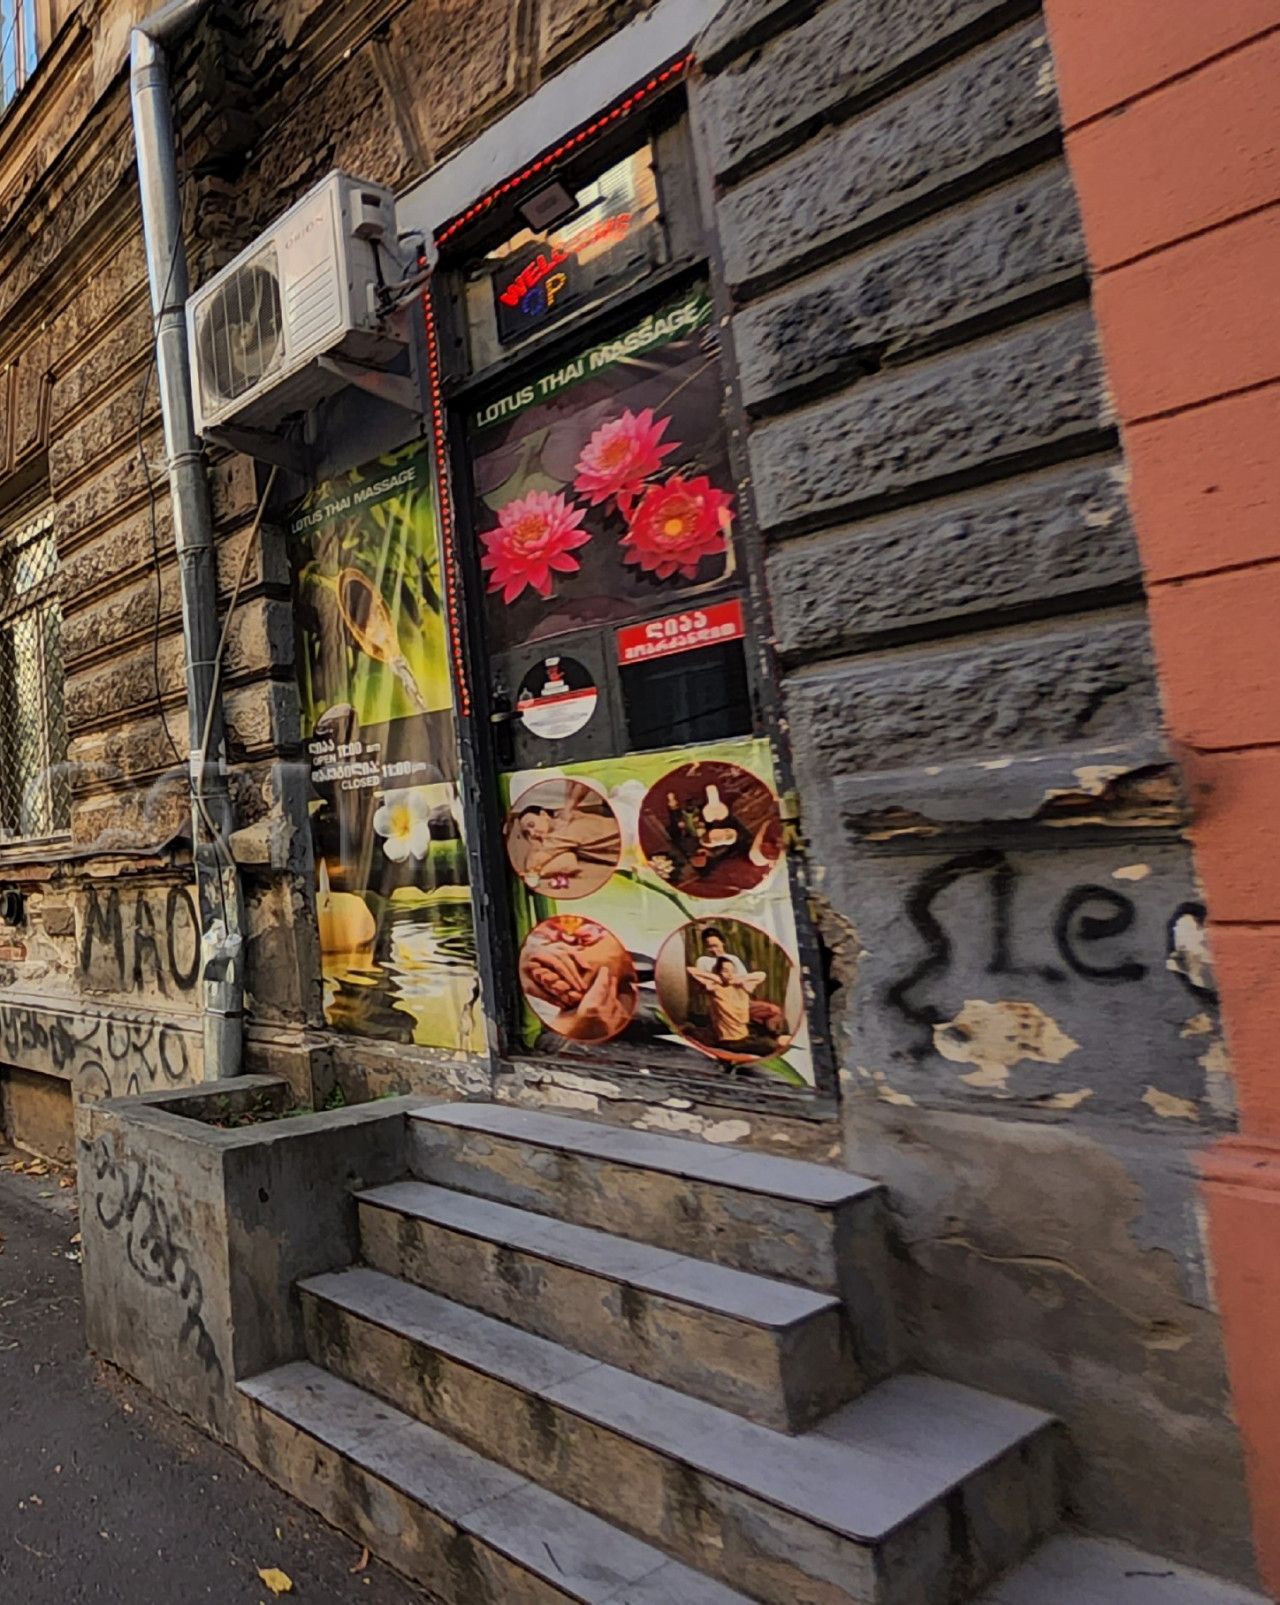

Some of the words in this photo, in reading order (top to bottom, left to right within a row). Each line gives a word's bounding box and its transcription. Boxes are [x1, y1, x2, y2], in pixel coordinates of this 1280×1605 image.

[476, 385, 535, 427] LOTUS
[538, 359, 584, 394] THAI
[589, 301, 701, 371] MASSAGE
[292, 510, 323, 534] LOTUS
[325, 496, 350, 517] THAI
[354, 466, 417, 505] MASSAGE
[313, 754, 336, 766] OPEN
[342, 775, 380, 790] CLOSED
